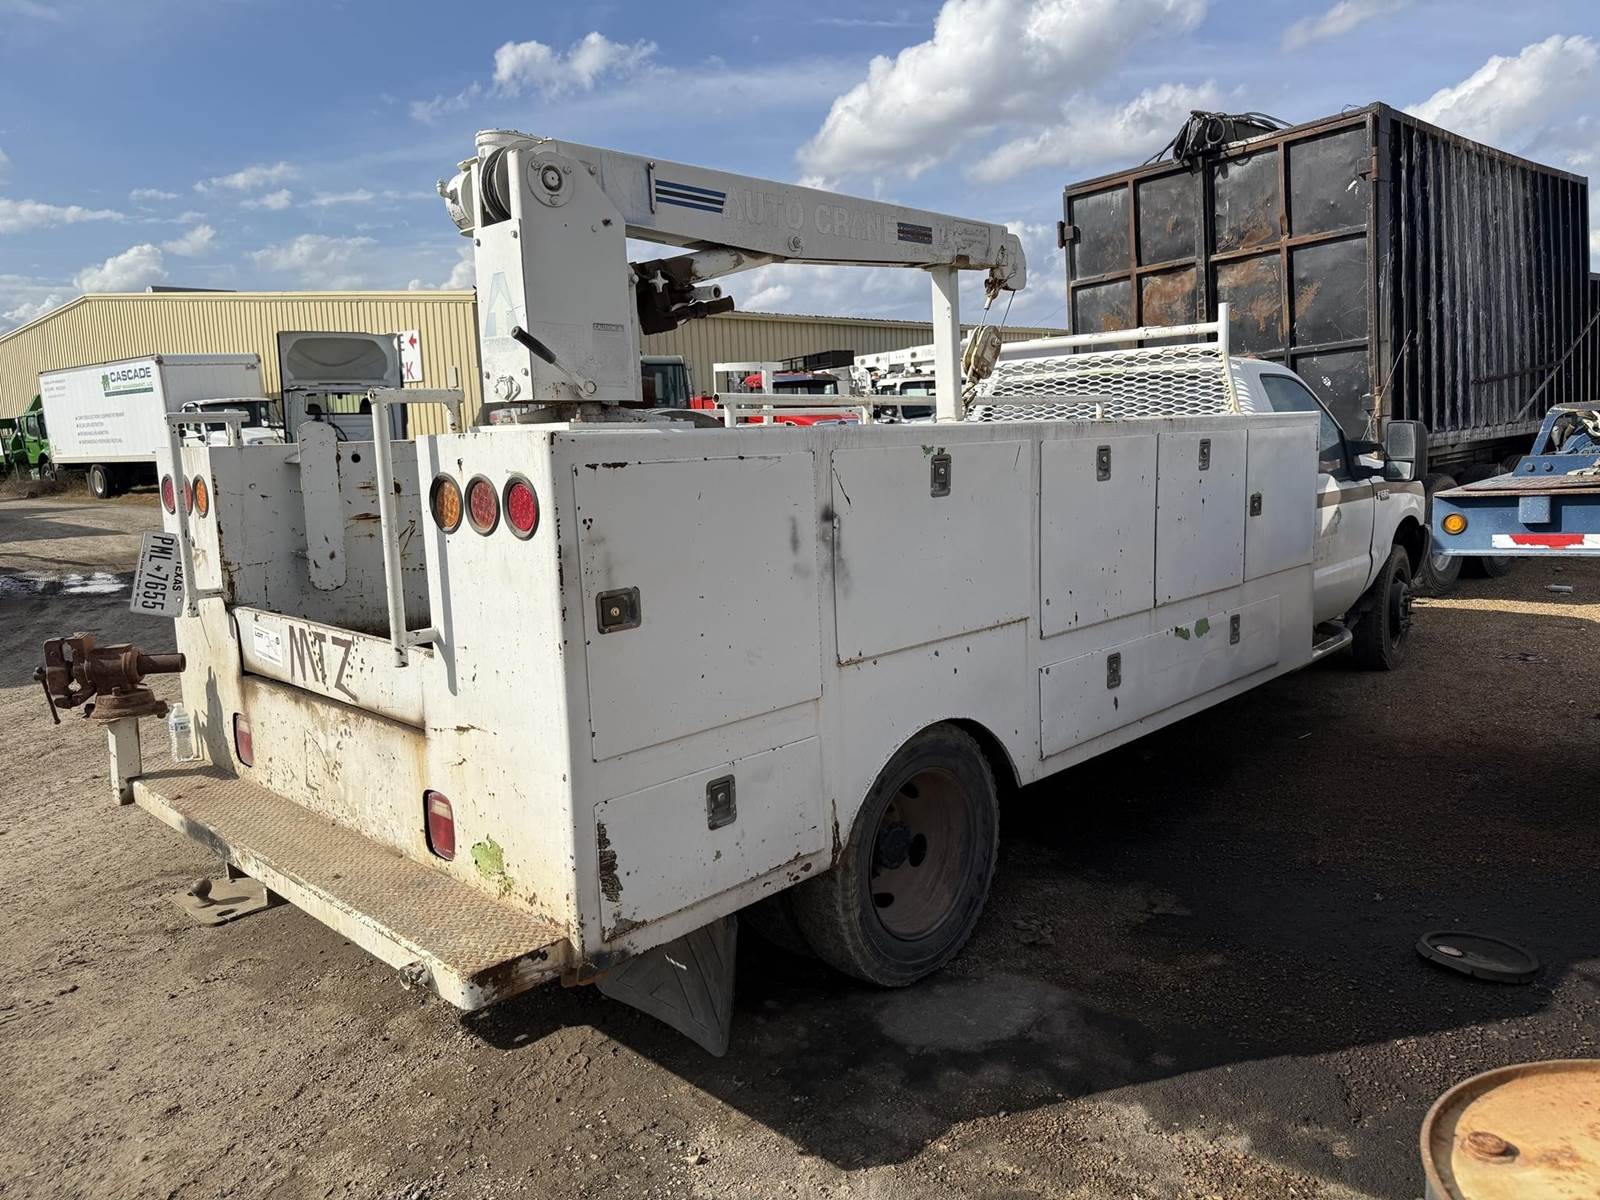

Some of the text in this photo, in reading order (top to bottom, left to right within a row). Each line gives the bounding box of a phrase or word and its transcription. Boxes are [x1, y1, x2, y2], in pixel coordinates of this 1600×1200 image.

[722, 185, 805, 230] AUTO
[814, 203, 897, 246] CRANE
[110, 367, 152, 382] CASCADE
[173, 561, 184, 591] TEXAS
